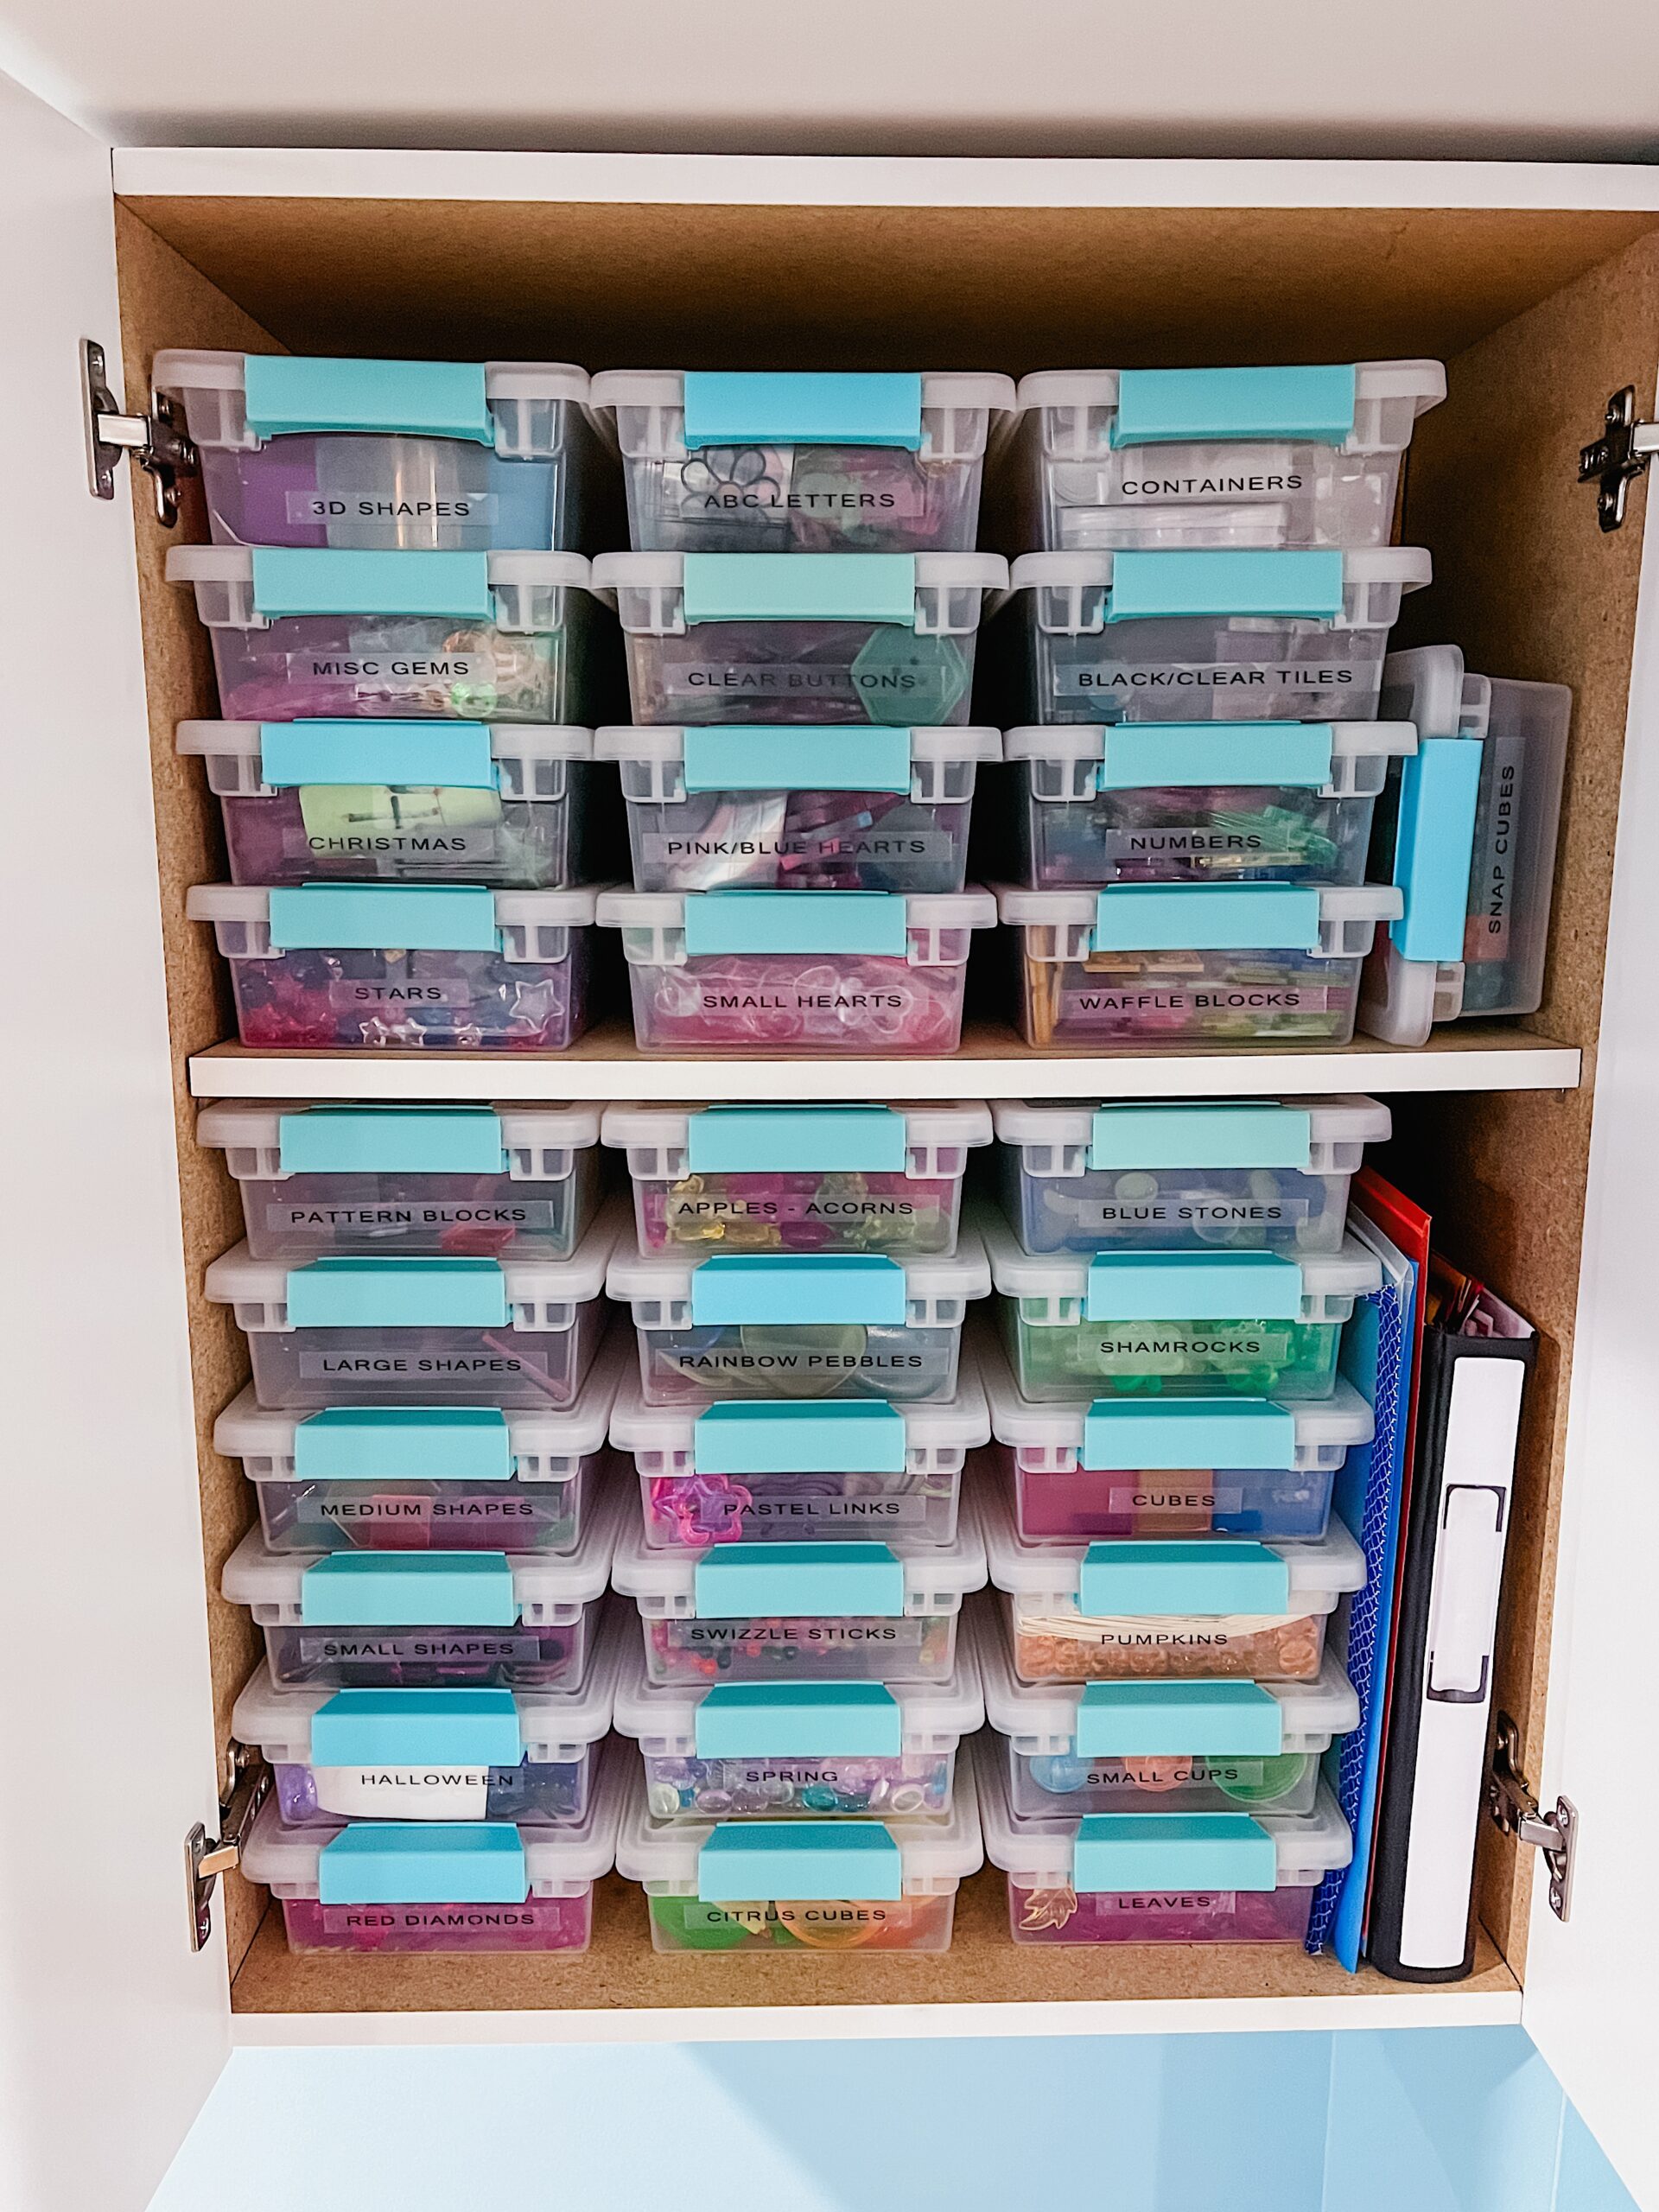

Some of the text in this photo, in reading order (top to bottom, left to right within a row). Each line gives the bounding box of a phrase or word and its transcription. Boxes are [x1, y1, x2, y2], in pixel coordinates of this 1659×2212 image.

[1122, 475, 1302, 495] CONTAINERS
[703, 493, 895, 508] ABC LETTERS
[312, 501, 470, 517] 3D SHAPES
[313, 662, 469, 675] MISC GEMS
[688, 672, 916, 688] CLEAR BUTTONS
[1079, 670, 1352, 687] BLACK/CLEAR TILES
[308, 837, 467, 851] CHRISTMAS
[668, 841, 925, 855] PINK/BLUE HEARTS
[1131, 835, 1262, 849] NUMBERS
[1489, 766, 1515, 934] SNAP CUBES
[354, 987, 442, 1000] STARS
[702, 995, 902, 1008] SMALL HEARTS
[1079, 994, 1300, 1010] WAFFLE BLOCKS
[678, 1202, 778, 1215] APPLES
[805, 1202, 913, 1215] ACORNS
[1103, 1206, 1282, 1219] BLUE STONES
[291, 1209, 526, 1223] PATTERN BLOCKS
[1100, 1341, 1260, 1353] SHAMROCKS
[323, 1359, 521, 1371] LARGE SHAPES
[679, 1356, 922, 1368] RAINBOW PEBBLES
[1132, 1495, 1216, 1506] CUBES
[321, 1503, 533, 1516] MEDIUM SHAPES
[724, 1503, 899, 1516] PASTEL LINKS
[691, 1628, 896, 1640] SWIZZLE STICKS
[1101, 1634, 1228, 1645] PUMPKINS
[324, 1643, 513, 1656] SMALL SHAPES
[361, 1775, 513, 1785] HALLOWEEN
[746, 1771, 838, 1783] SPRING
[1087, 1769, 1238, 1784] SMALL CUPS
[1118, 1897, 1211, 1909] LEAVES
[346, 1914, 535, 1927] RED DIAMONDS
[707, 1910, 886, 1923] CITRUS CUBES
